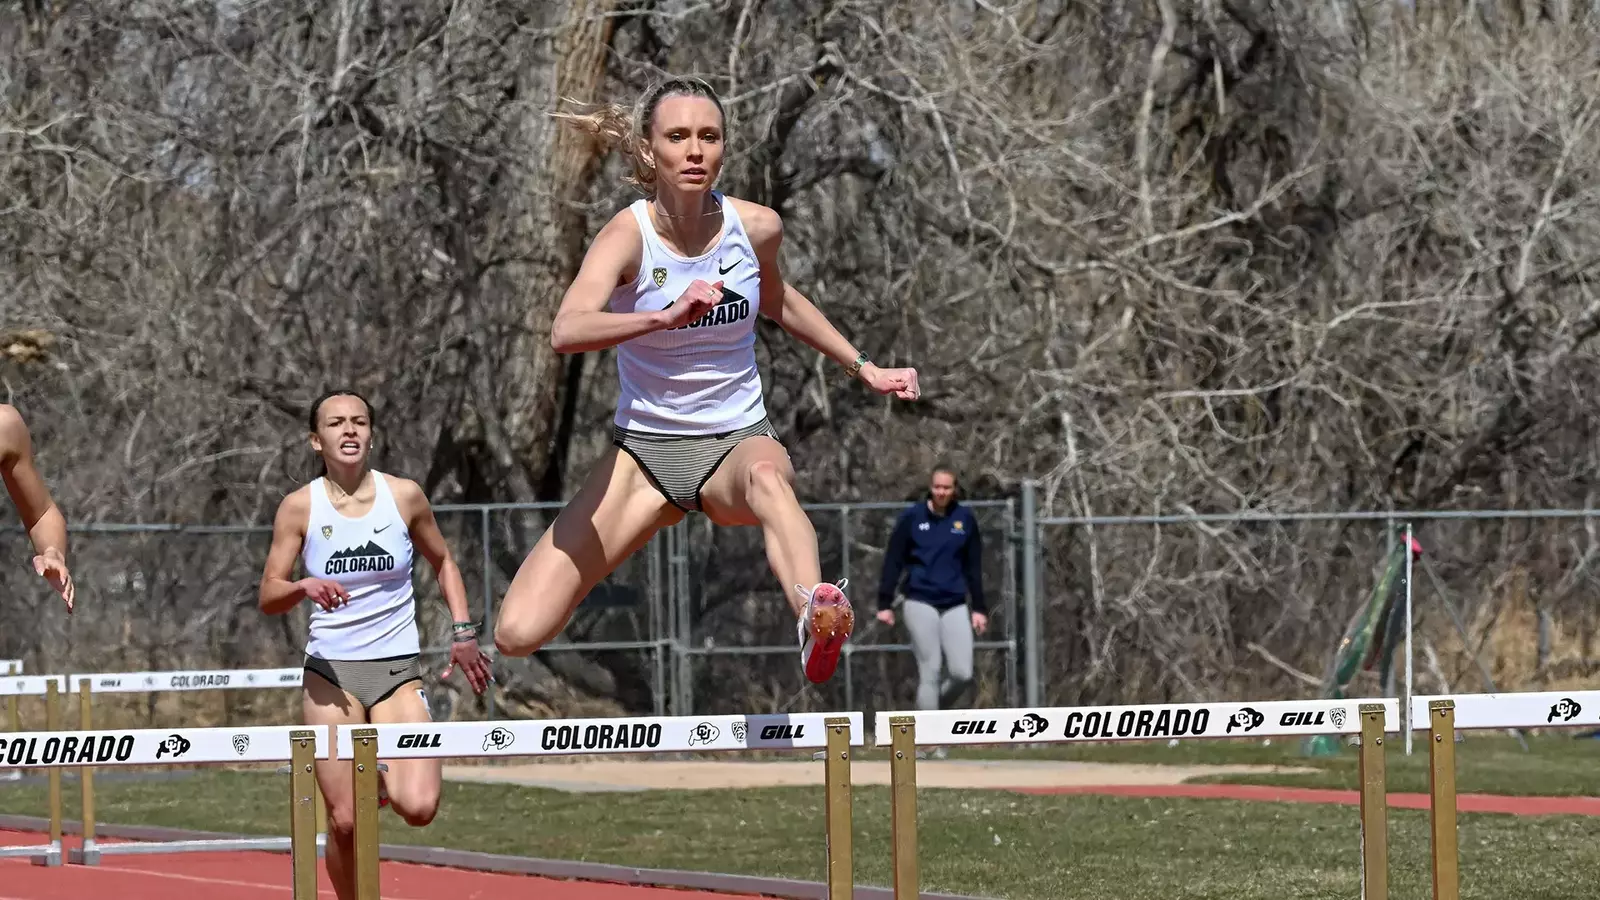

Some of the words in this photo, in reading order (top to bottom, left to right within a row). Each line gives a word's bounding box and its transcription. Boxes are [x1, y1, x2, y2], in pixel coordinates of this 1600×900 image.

[666, 299, 750, 331] RADO
[325, 556, 394, 575] COLORADO
[952, 721, 996, 734] GILL
[1064, 709, 1209, 738] COLORADO
[1280, 712, 1324, 726] GILL
[397, 734, 441, 748] GILL
[541, 724, 662, 750] COLORADO
[760, 725, 803, 740] GILL
